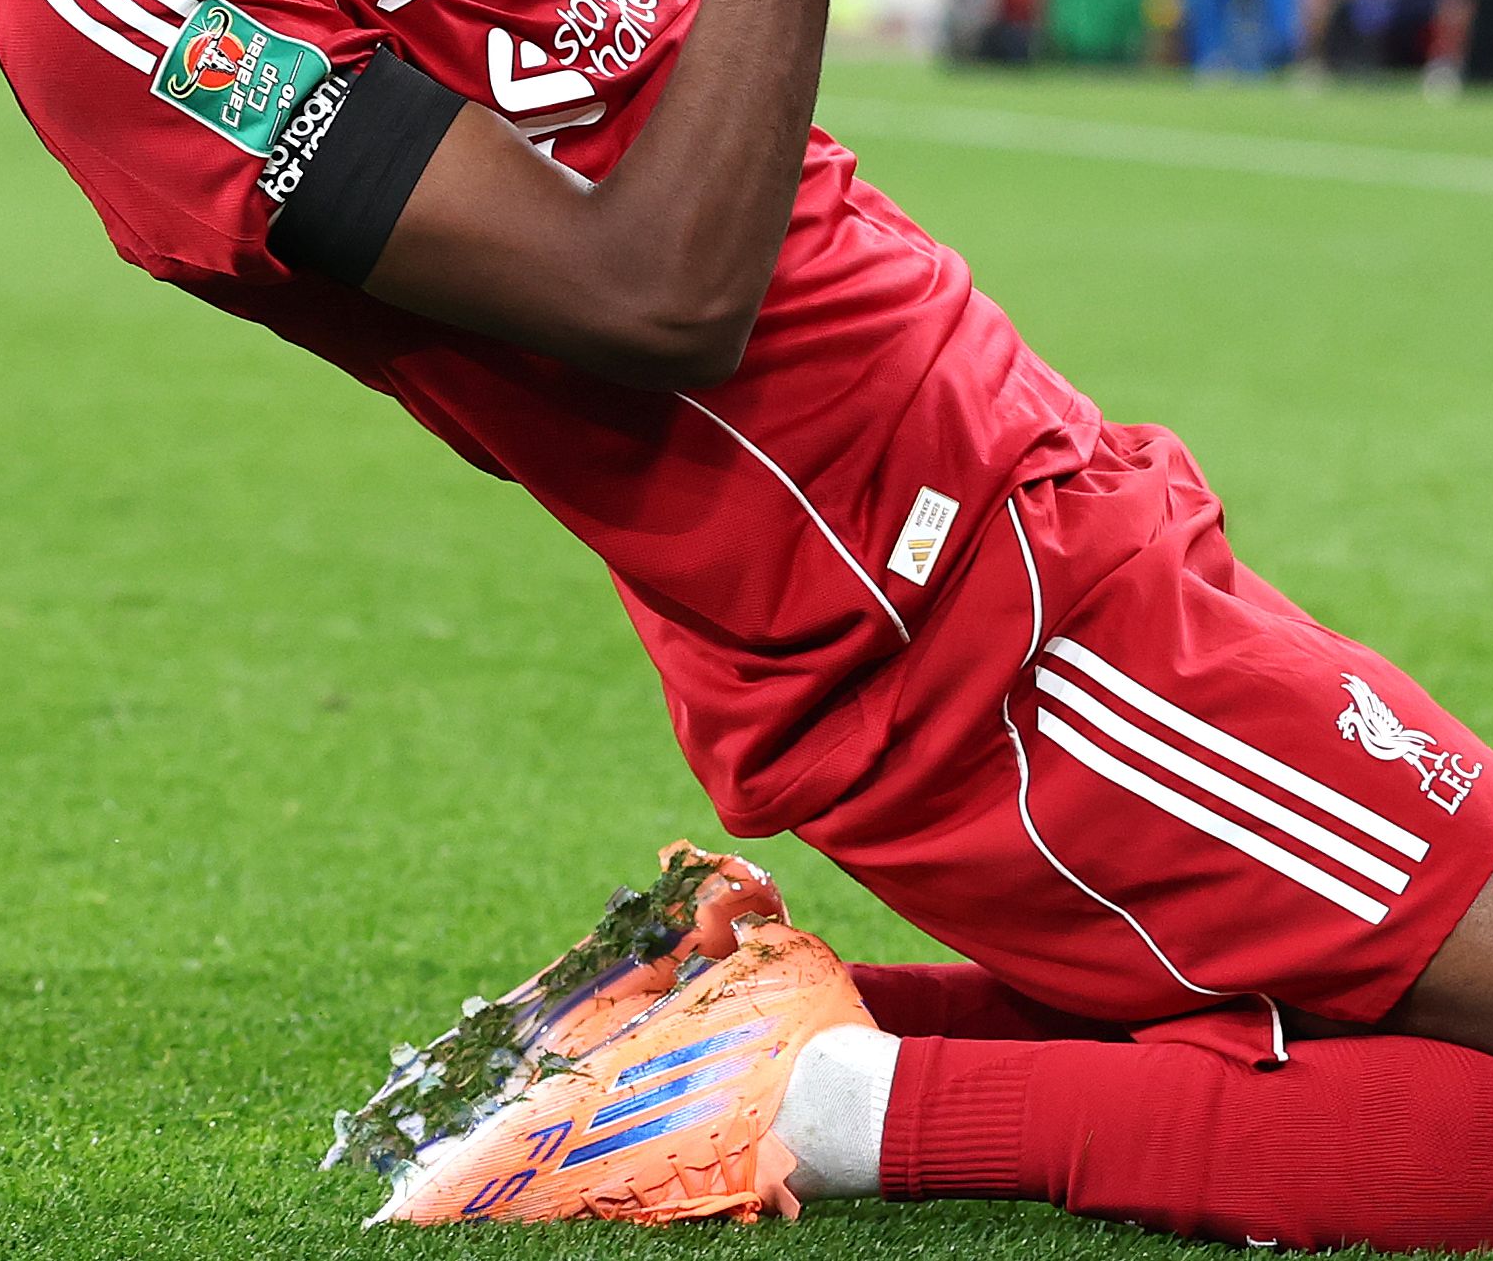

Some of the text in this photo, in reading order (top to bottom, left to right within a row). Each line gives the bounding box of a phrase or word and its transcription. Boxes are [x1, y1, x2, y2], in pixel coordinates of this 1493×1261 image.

[220, 31, 269, 130] Carabao
[246, 62, 279, 113] Cup
[276, 82, 296, 109] 10
[281, 76, 349, 147] room
